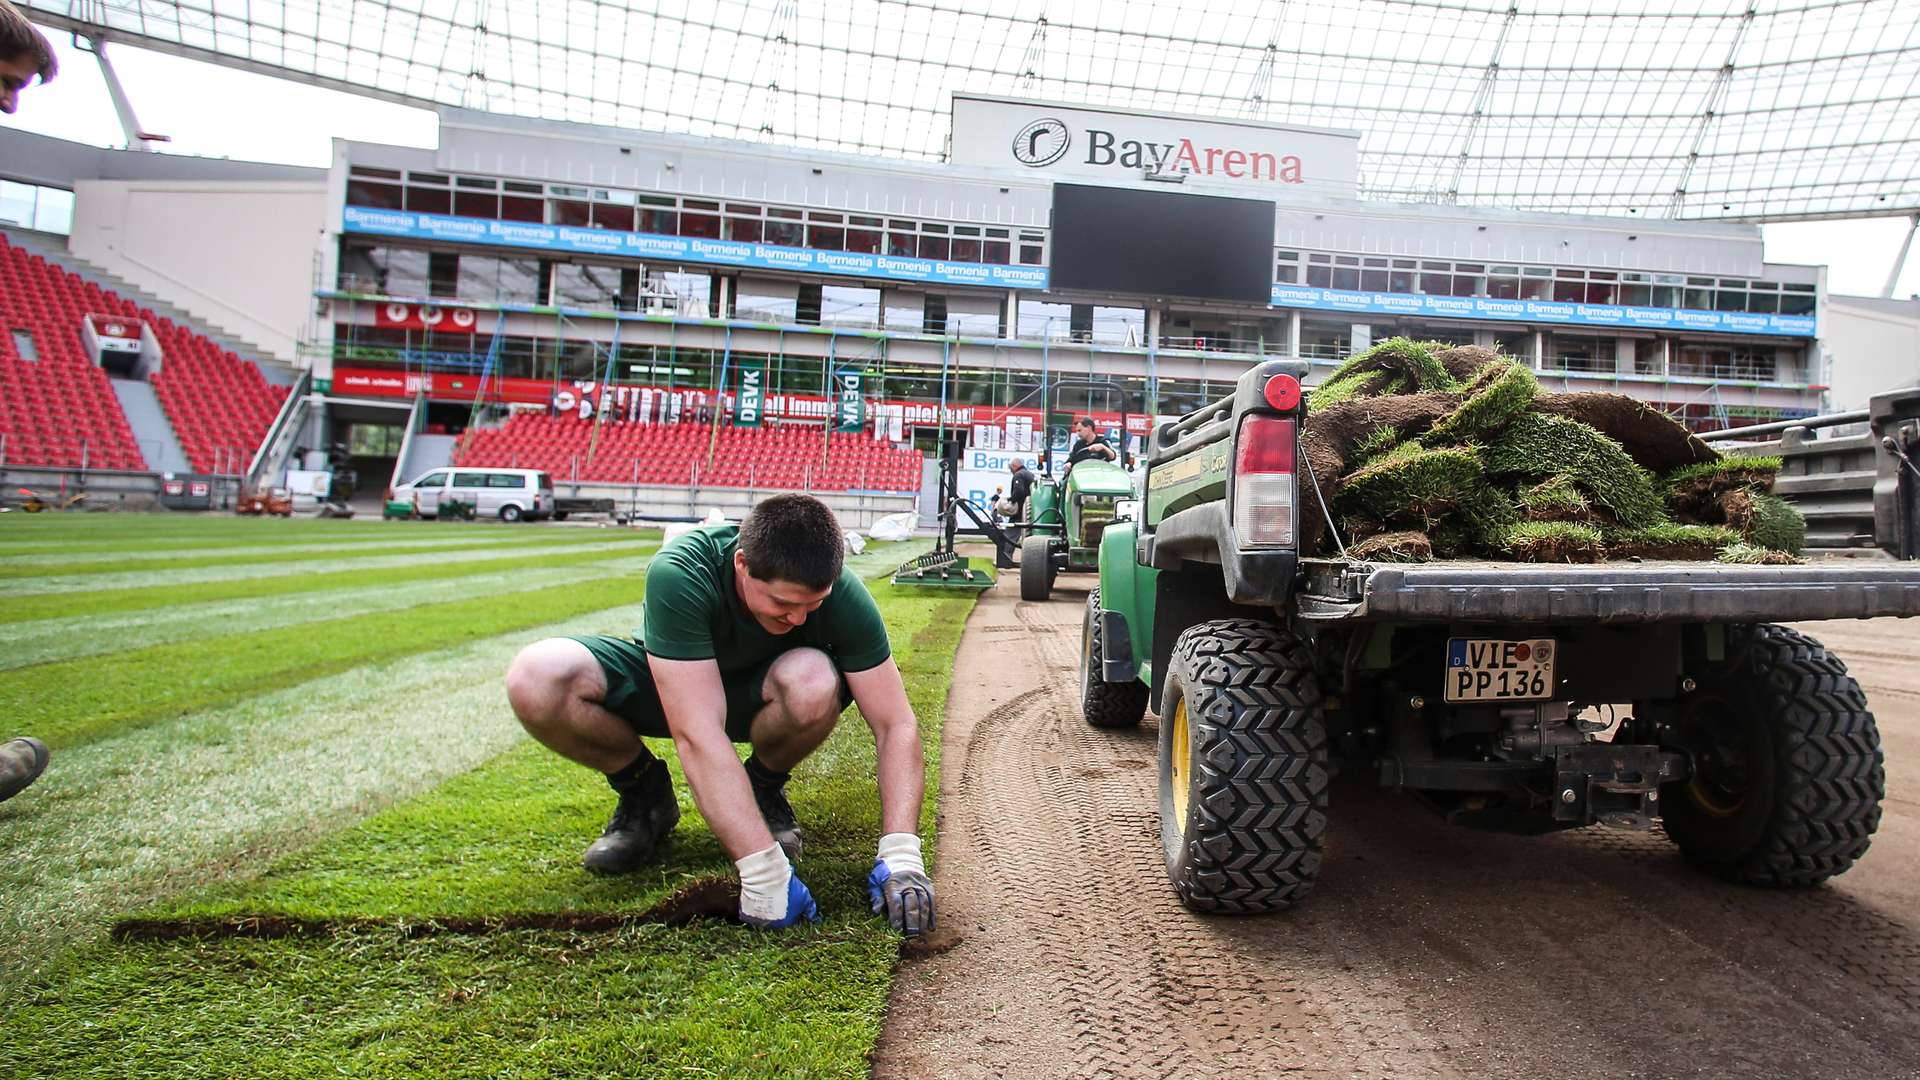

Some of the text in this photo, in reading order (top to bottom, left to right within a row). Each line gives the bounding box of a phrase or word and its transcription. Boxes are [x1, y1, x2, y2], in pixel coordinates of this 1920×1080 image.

[1084, 129, 1304, 184] BayArena
[560, 228, 622, 244] Barmenia
[627, 235, 687, 250] Barmenia
[692, 240, 750, 257] Barmenia
[755, 247, 813, 262] Barmenia
[817, 253, 872, 268] Barmenia
[877, 257, 931, 273] Barmenia
[936, 263, 989, 277] Barmenia
[993, 267, 1045, 280] Barmenia
[1271, 287, 1319, 300] Barmenia
[1323, 291, 1370, 304] Barmenia
[1375, 294, 1422, 307] Barmenia
[1426, 298, 1472, 310] Barmenia
[1477, 301, 1523, 313] Barmenia
[1527, 303, 1573, 315] Barmenia
[1577, 306, 1622, 318] Barmenia
[1626, 308, 1672, 320] Barmenia
[740, 370, 760, 422] DEVK
[843, 375, 860, 425] DEVK
[1470, 642, 1518, 669] VIE
[1457, 670, 1545, 697] PP 136
